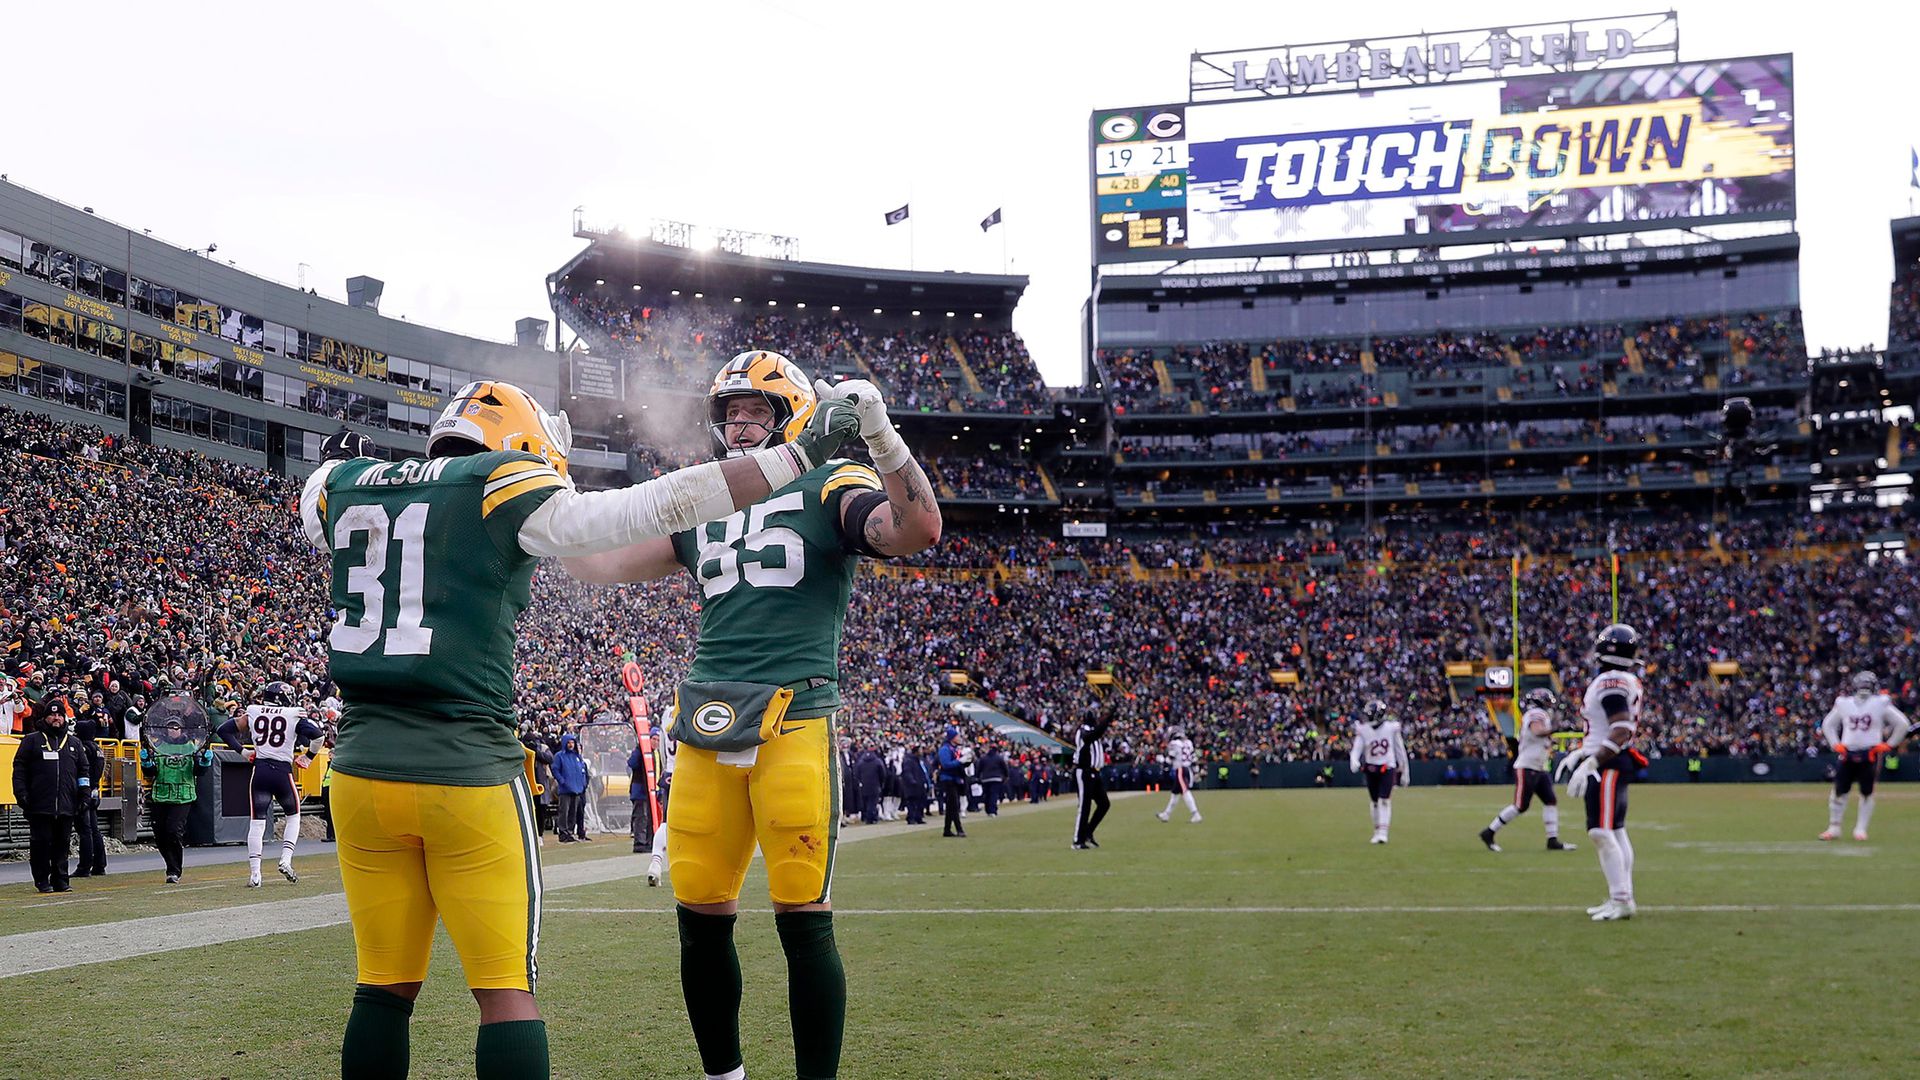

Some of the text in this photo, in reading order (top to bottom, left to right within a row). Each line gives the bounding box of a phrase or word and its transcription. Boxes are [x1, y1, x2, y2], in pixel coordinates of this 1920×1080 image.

[1232, 28, 1635, 92] LAMBEAU FIELD
[1108, 145, 1177, 169] 19 21
[1160, 276, 1199, 288] WORLD
[1200, 274, 1265, 288] CHAMPIONS
[299, 364, 354, 385] CHARLES WOODSON
[396, 388, 440, 405] LEROY BUTLER
[354, 456, 454, 487] WILSON
[696, 491, 804, 600] 85
[328, 502, 433, 656] 31
[1489, 670, 1509, 686] 40
[254, 715, 287, 748] 98
[697, 706, 730, 732] G
[1370, 739, 1389, 757] 29
